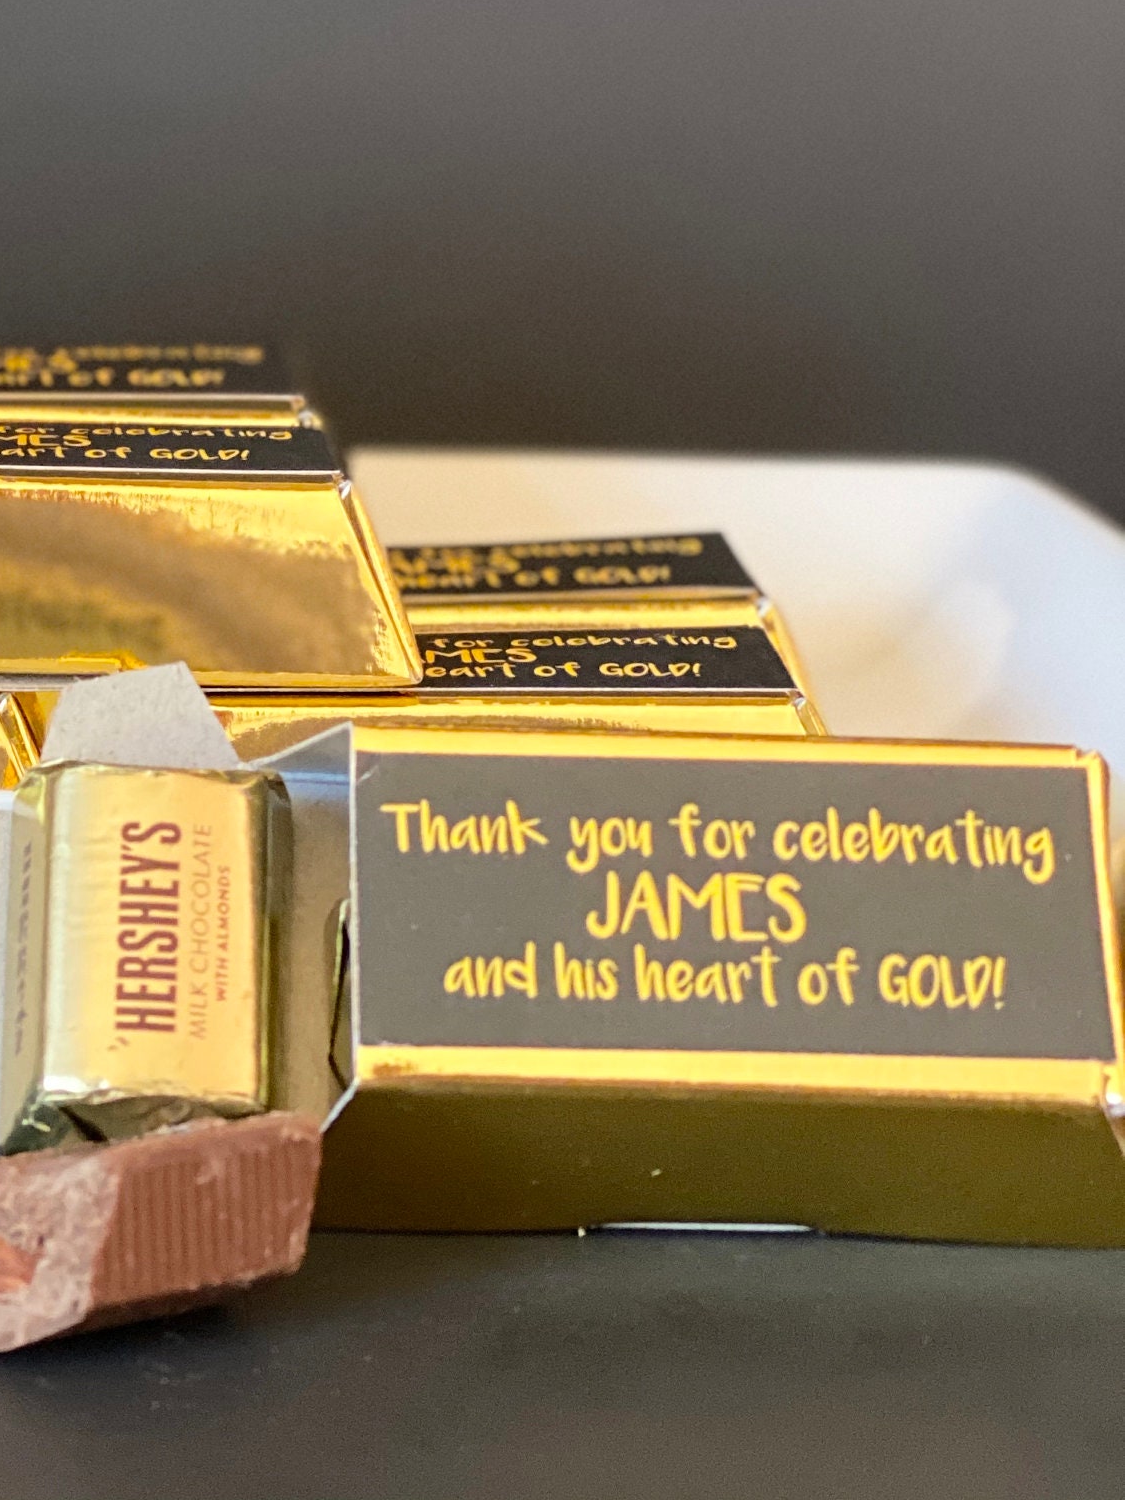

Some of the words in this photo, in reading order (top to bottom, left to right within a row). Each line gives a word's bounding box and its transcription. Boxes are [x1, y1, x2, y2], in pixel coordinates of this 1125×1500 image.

[84, 446, 133, 459] of
[149, 447, 250, 461] GOLD!
[421, 647, 537, 664] MES
[425, 662, 517, 679] eart
[533, 661, 582, 678] of
[599, 662, 702, 678] GOLD!
[429, 638, 496, 649] for
[510, 633, 738, 649] celebrating
[380, 799, 548, 854] Thank
[566, 818, 653, 873] you
[670, 804, 757, 859] for
[773, 807, 1056, 885] celebrating
[115, 821, 182, 1033] HERSHEY'S
[189, 823, 213, 975] CHOCOLATE
[217, 864, 232, 952] ALMONDS
[585, 870, 808, 943] JAMES
[215, 956, 231, 1002] WITH
[443, 941, 537, 998] and
[553, 942, 619, 1001] his
[633, 944, 781, 1007] heart
[798, 947, 861, 1006] of
[878, 954, 1007, 1011] GOLD!
[189, 982, 209, 1041] MILK
